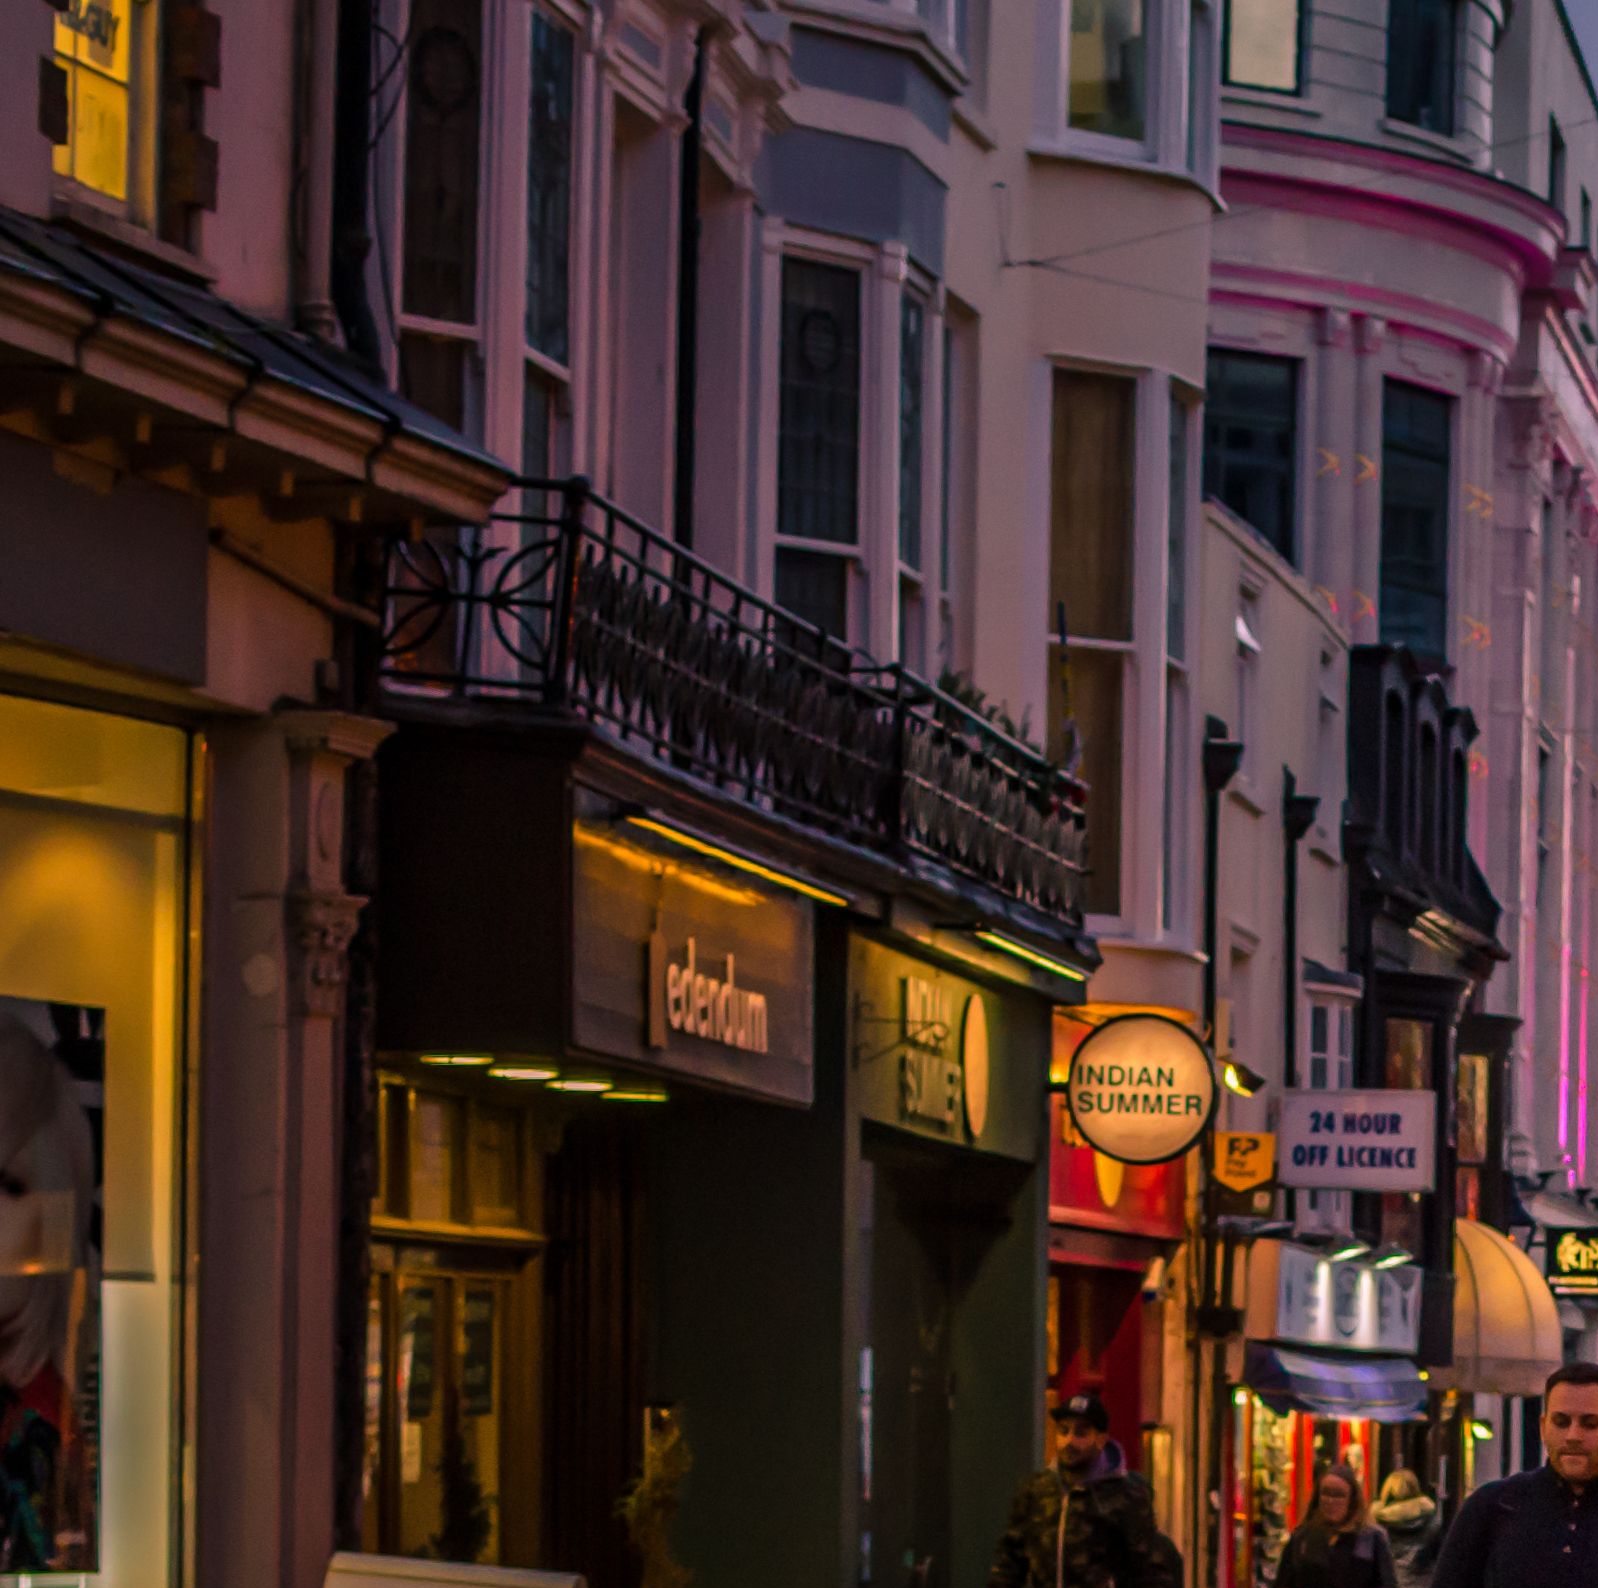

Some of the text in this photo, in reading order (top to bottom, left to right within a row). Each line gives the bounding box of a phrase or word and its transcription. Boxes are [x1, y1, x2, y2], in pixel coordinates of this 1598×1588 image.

[665, 936, 769, 1054] edendum
[1076, 1064, 1175, 1088] INDIAN
[1077, 1090, 1203, 1116] SUMMER
[1308, 1110, 1402, 1135] 24 HOUR
[1292, 1144, 1417, 1169] OFF LICENCE
